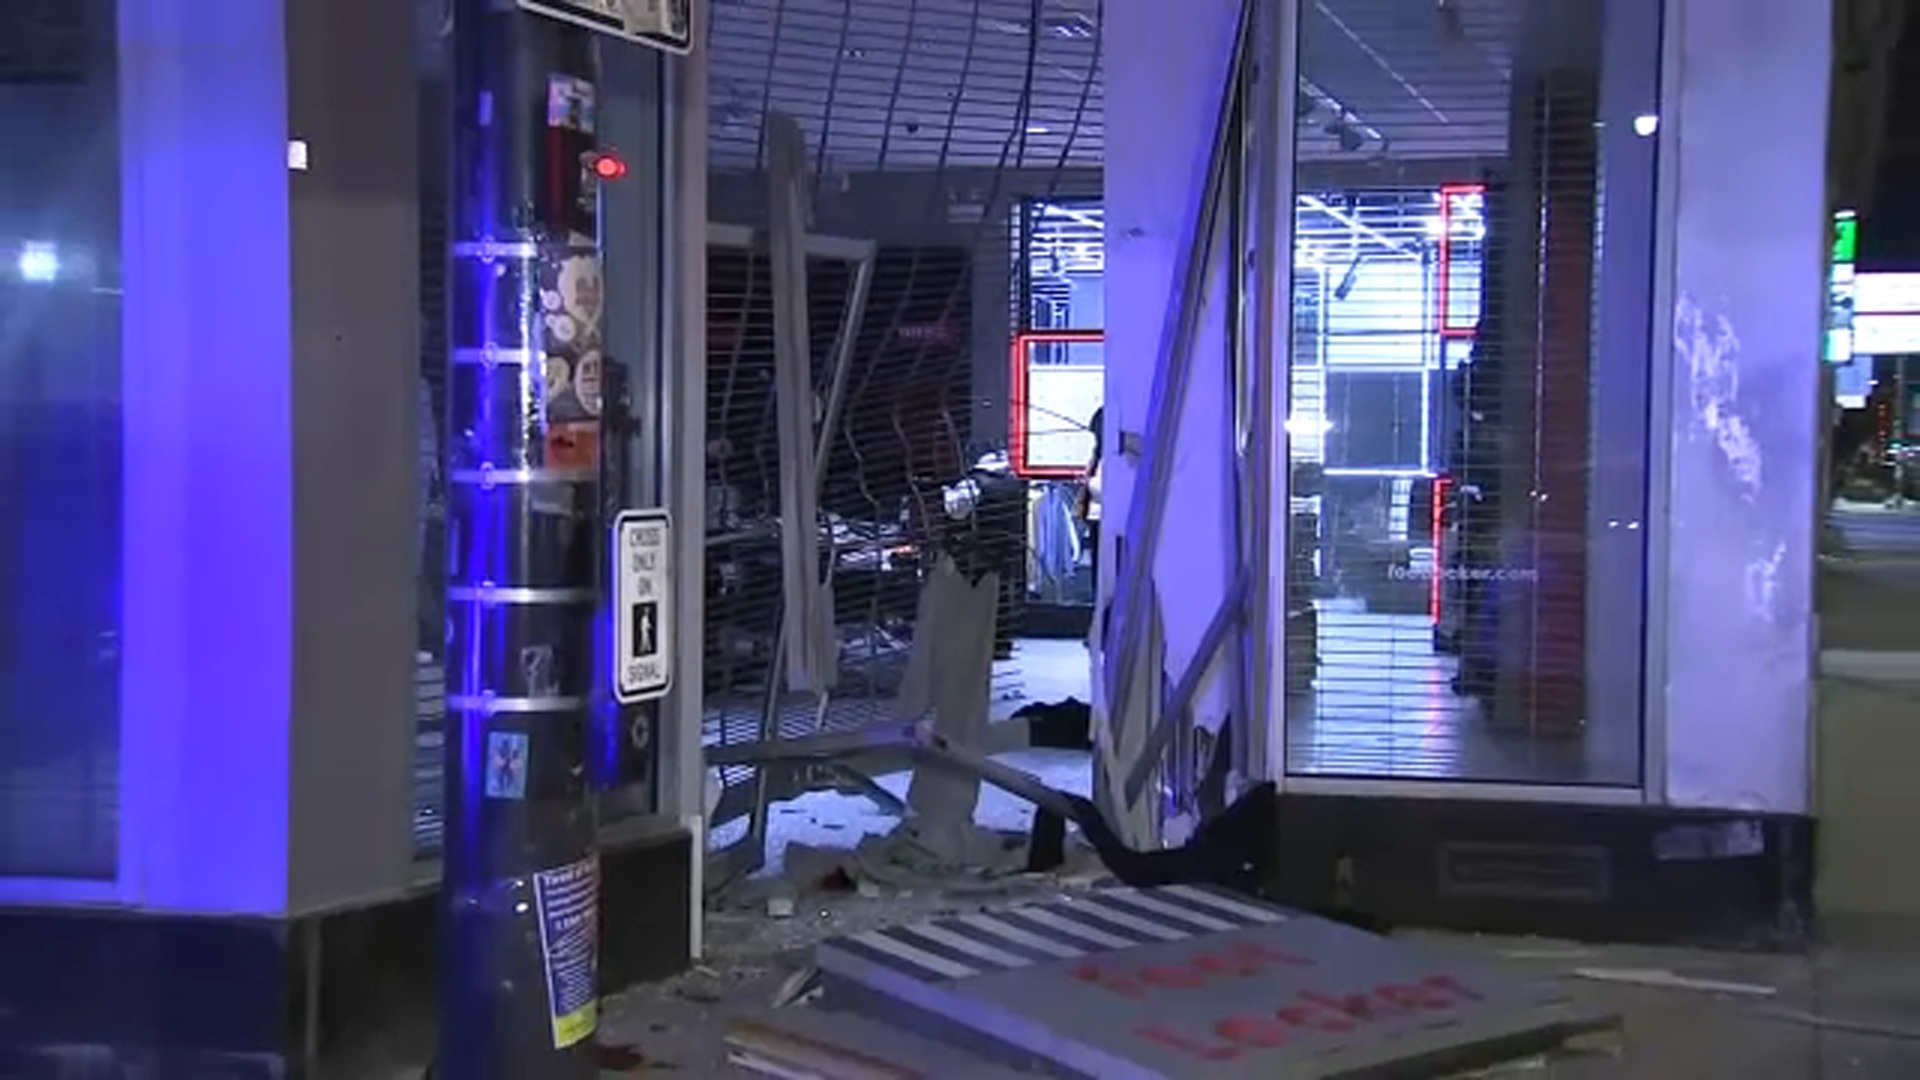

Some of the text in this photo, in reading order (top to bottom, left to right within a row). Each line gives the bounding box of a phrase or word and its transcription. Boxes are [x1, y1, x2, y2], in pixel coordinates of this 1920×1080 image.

[630, 528, 660, 546] CROSS
[632, 553, 655, 573] ONLY
[1388, 563, 1538, 581] footocker.com
[638, 577, 653, 596] ON
[628, 663, 661, 684] SIGNAL
[1131, 974, 1484, 1060] Locker
